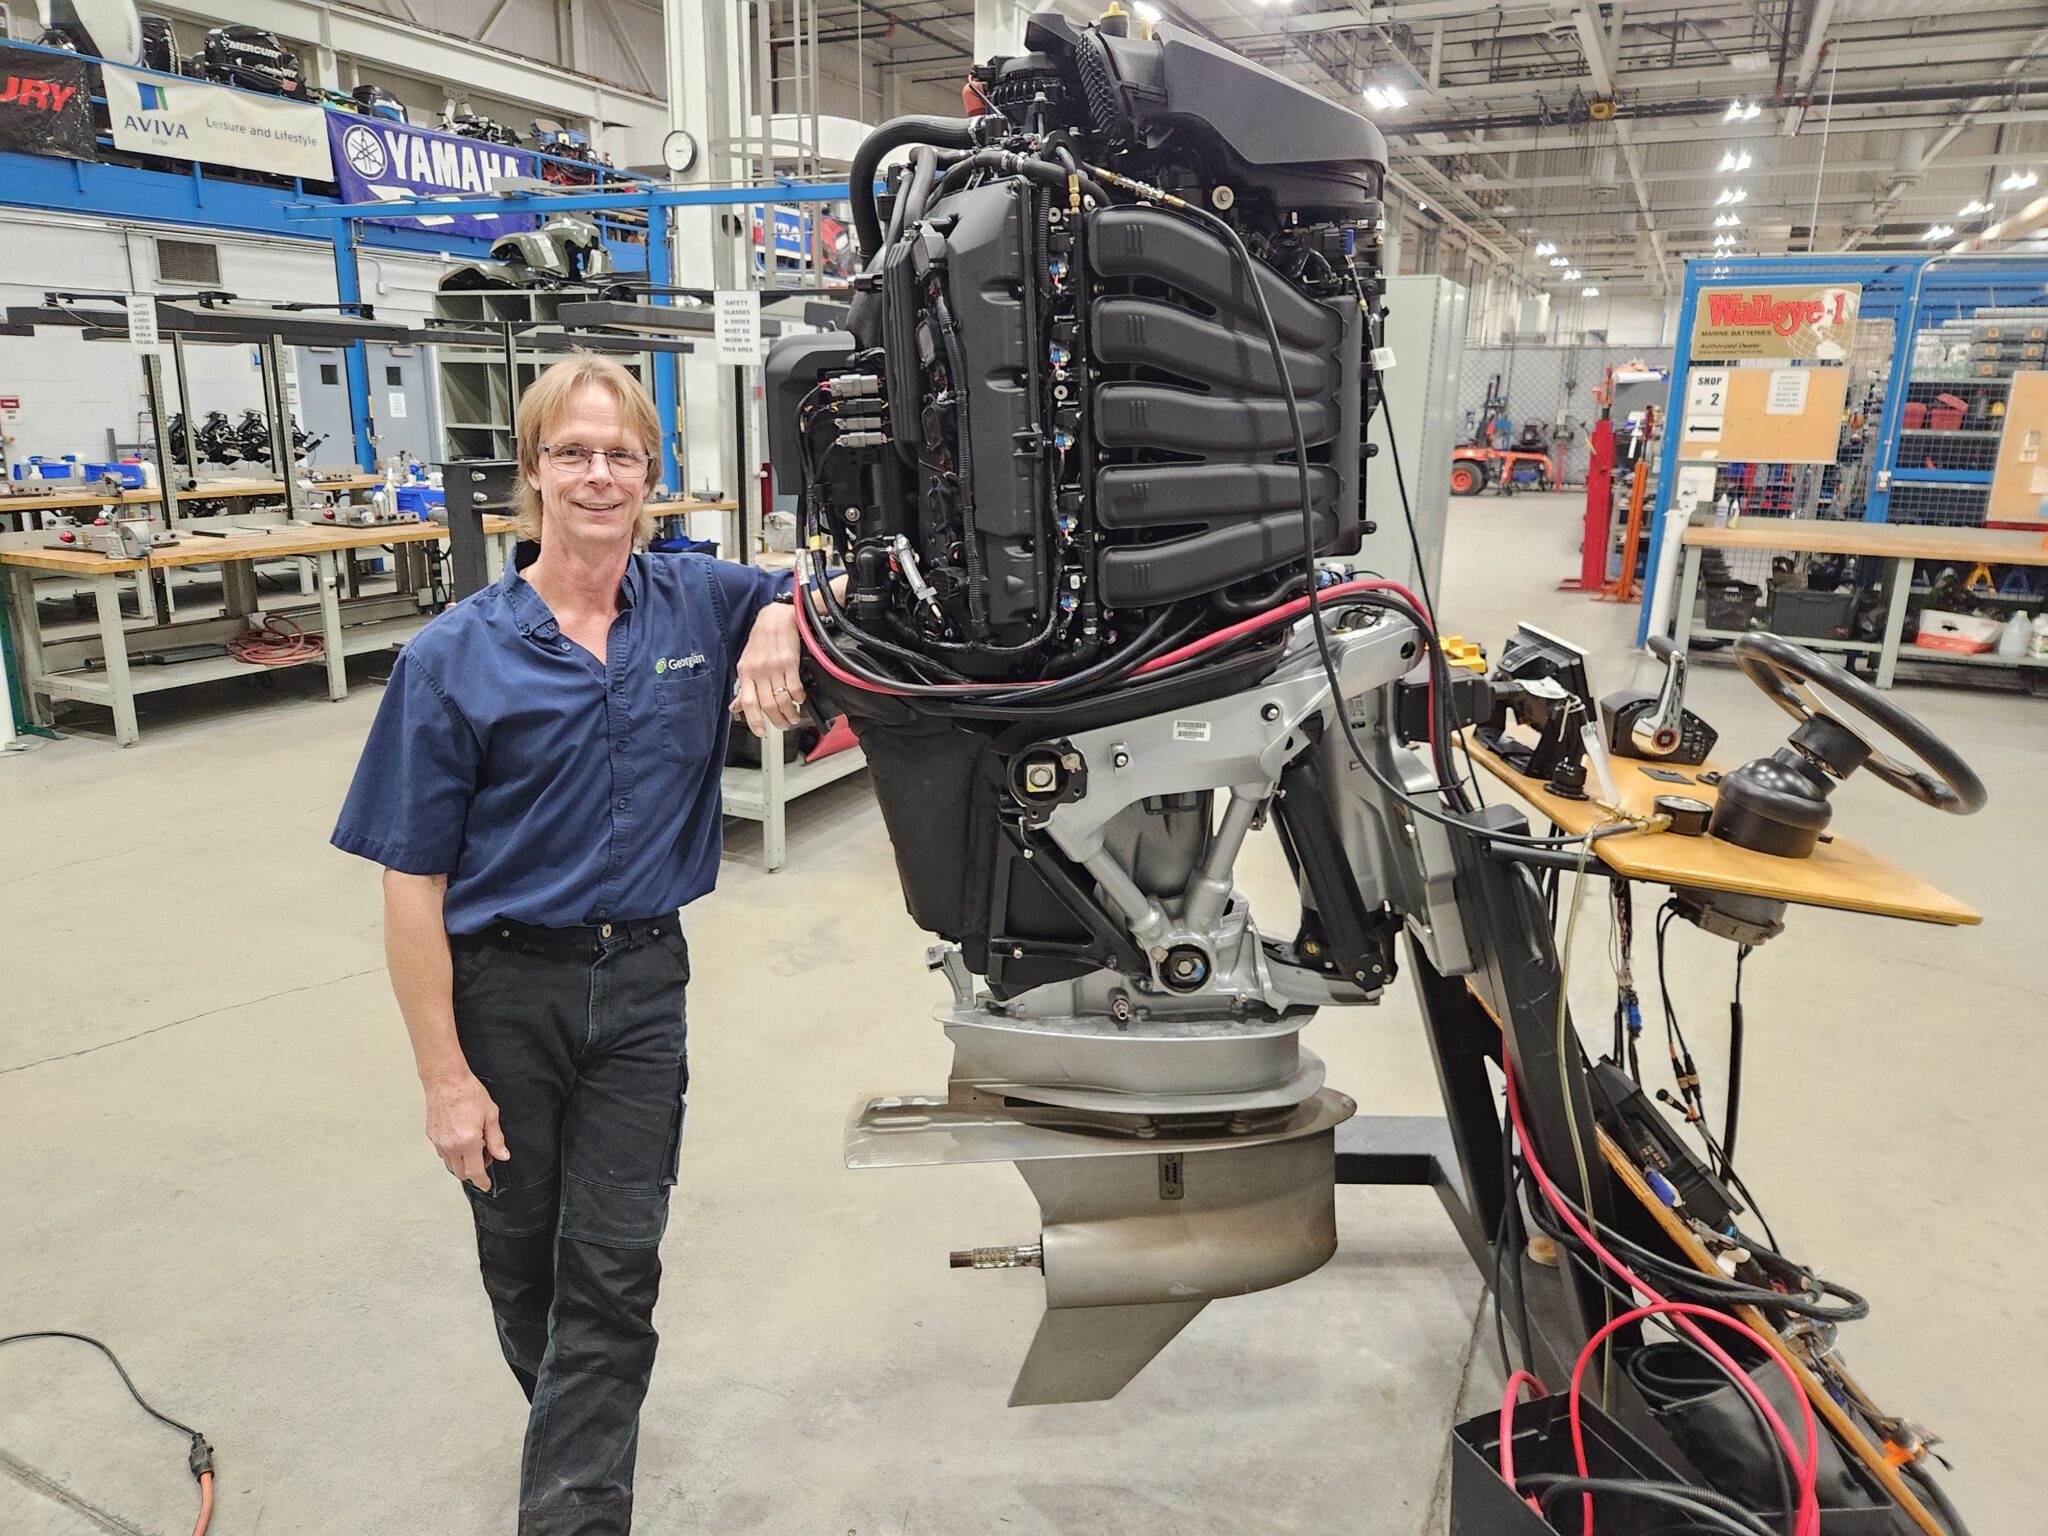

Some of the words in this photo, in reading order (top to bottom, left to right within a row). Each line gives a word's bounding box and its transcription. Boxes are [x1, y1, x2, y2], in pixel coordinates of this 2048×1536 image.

[229, 41, 282, 59] MERCURY
[125, 115, 189, 139] AVIVA
[206, 117, 246, 133] Leisure
[249, 127, 271, 138] and
[275, 130, 318, 147] Lifestyle
[384, 130, 519, 193] YAMAHA
[1698, 376, 1722, 386] SHOP
[1710, 392, 1719, 407] 2
[668, 652, 706, 670] Georgian
